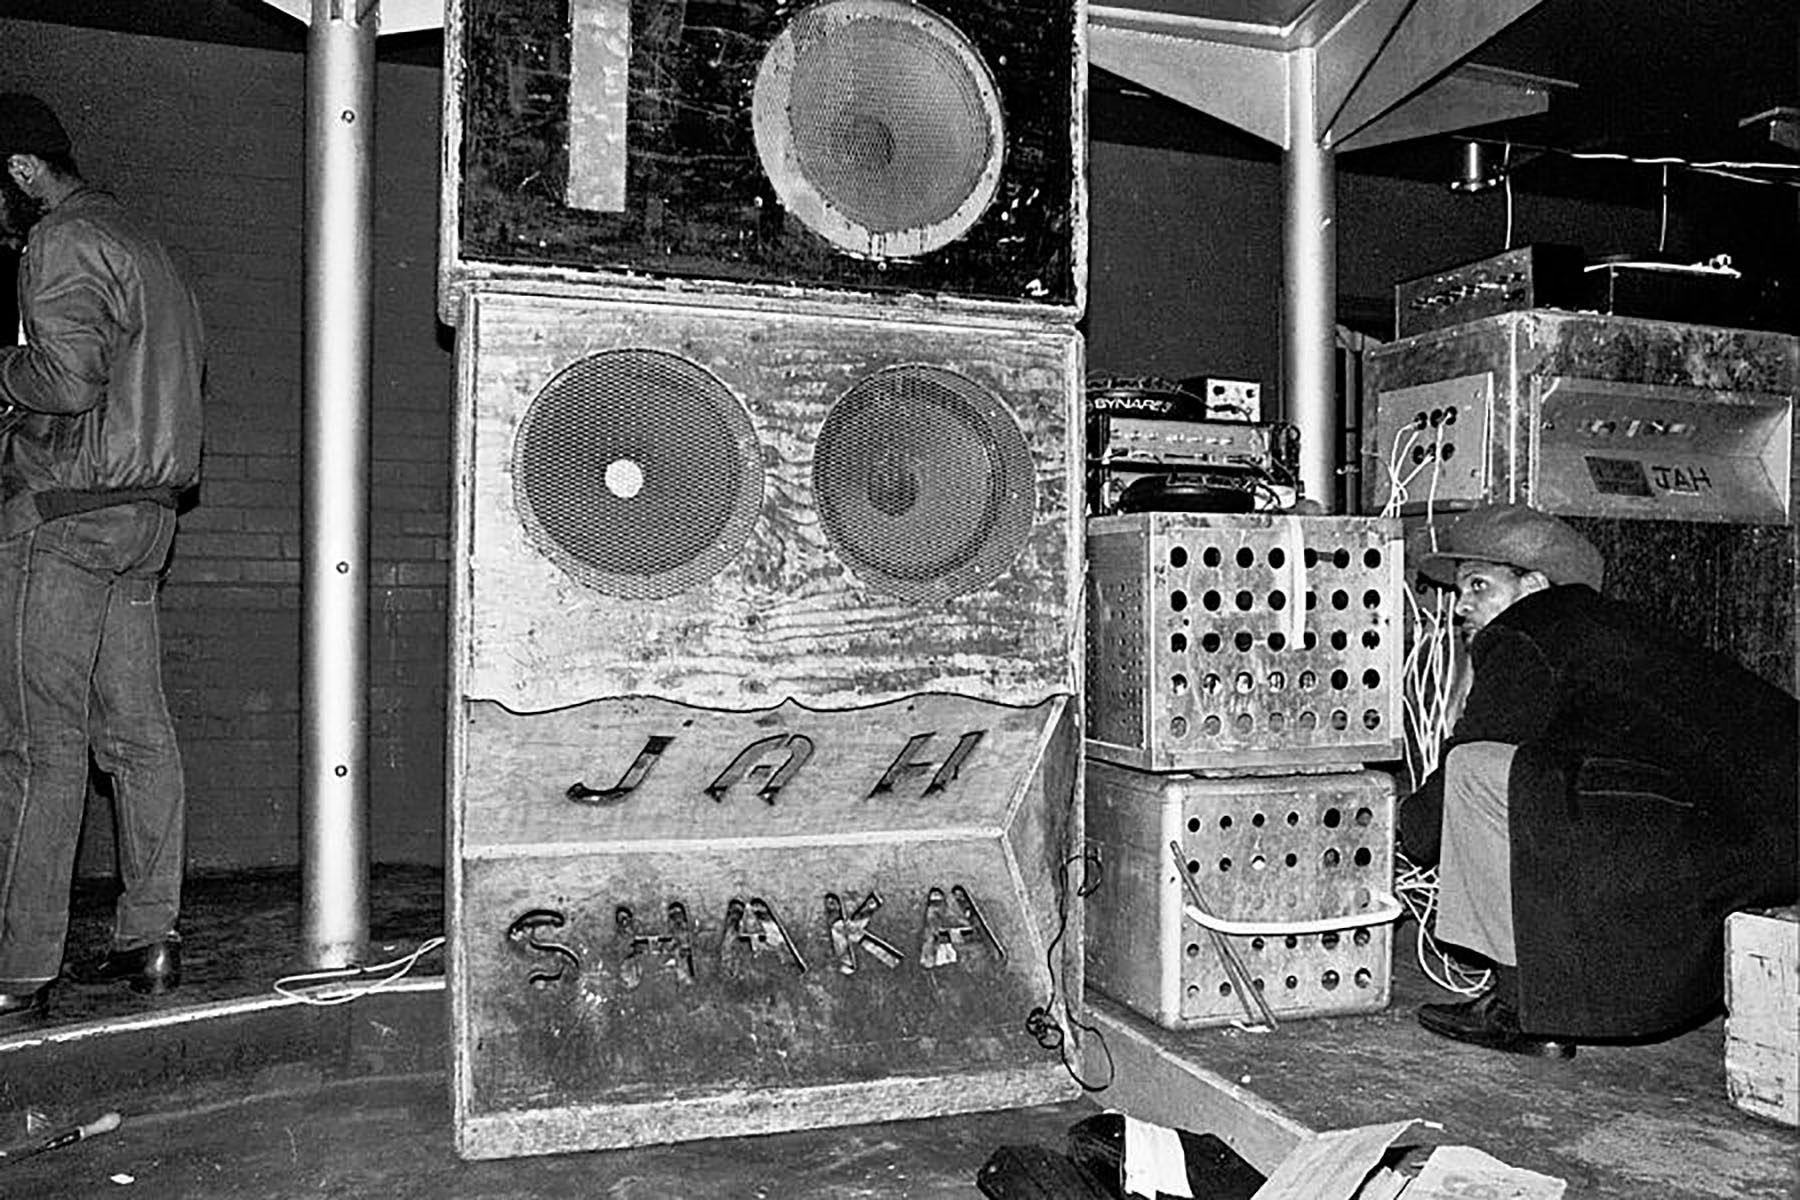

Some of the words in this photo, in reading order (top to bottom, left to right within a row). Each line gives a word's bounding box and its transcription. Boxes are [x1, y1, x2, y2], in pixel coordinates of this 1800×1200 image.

[1651, 464, 1713, 492] JAH
[566, 730, 989, 805] JAH
[508, 885, 1008, 989] SHAKA
